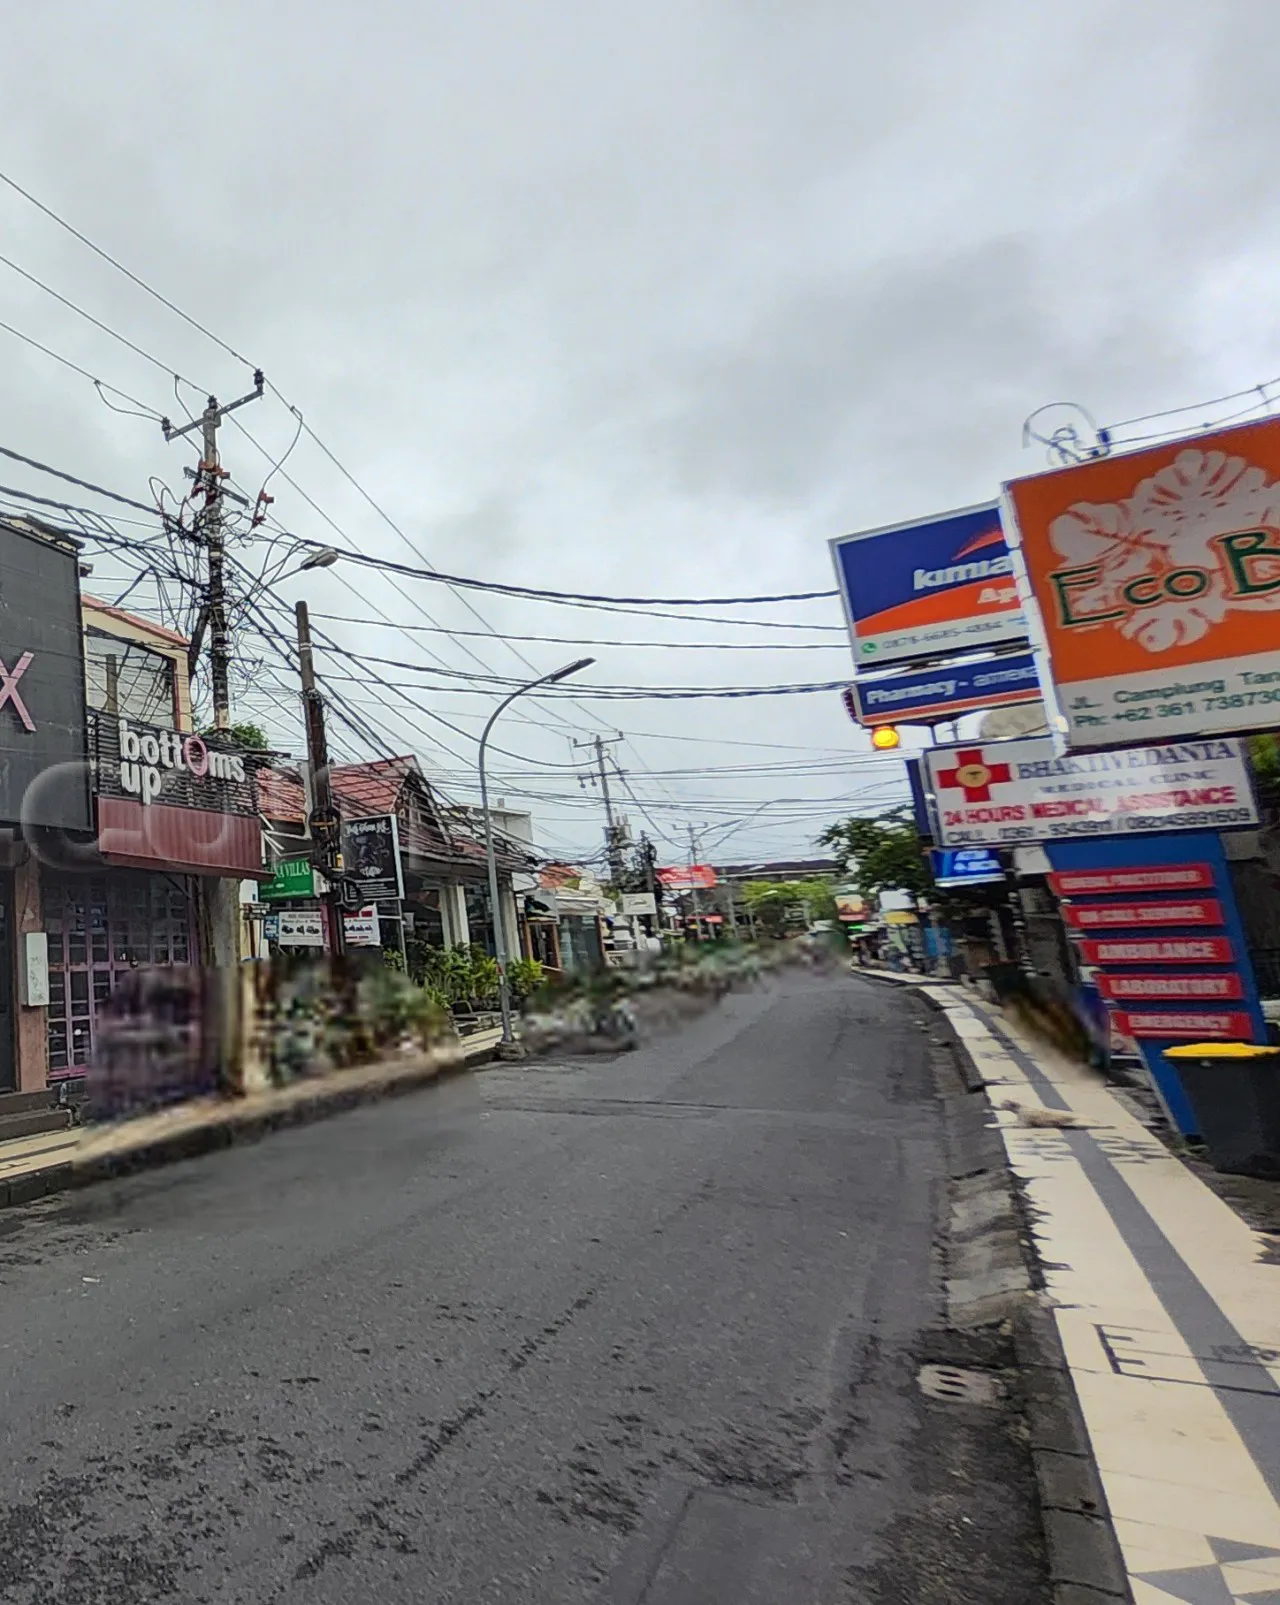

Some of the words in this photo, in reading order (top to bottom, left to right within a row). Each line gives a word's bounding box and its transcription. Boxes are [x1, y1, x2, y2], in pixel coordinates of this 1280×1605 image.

[121, 762, 162, 805] up
[944, 810, 963, 826] 24
[966, 805, 1025, 825] HOURS
[1028, 798, 1111, 818] MEDICAL
[1116, 786, 1237, 813] ASSISTANCE
